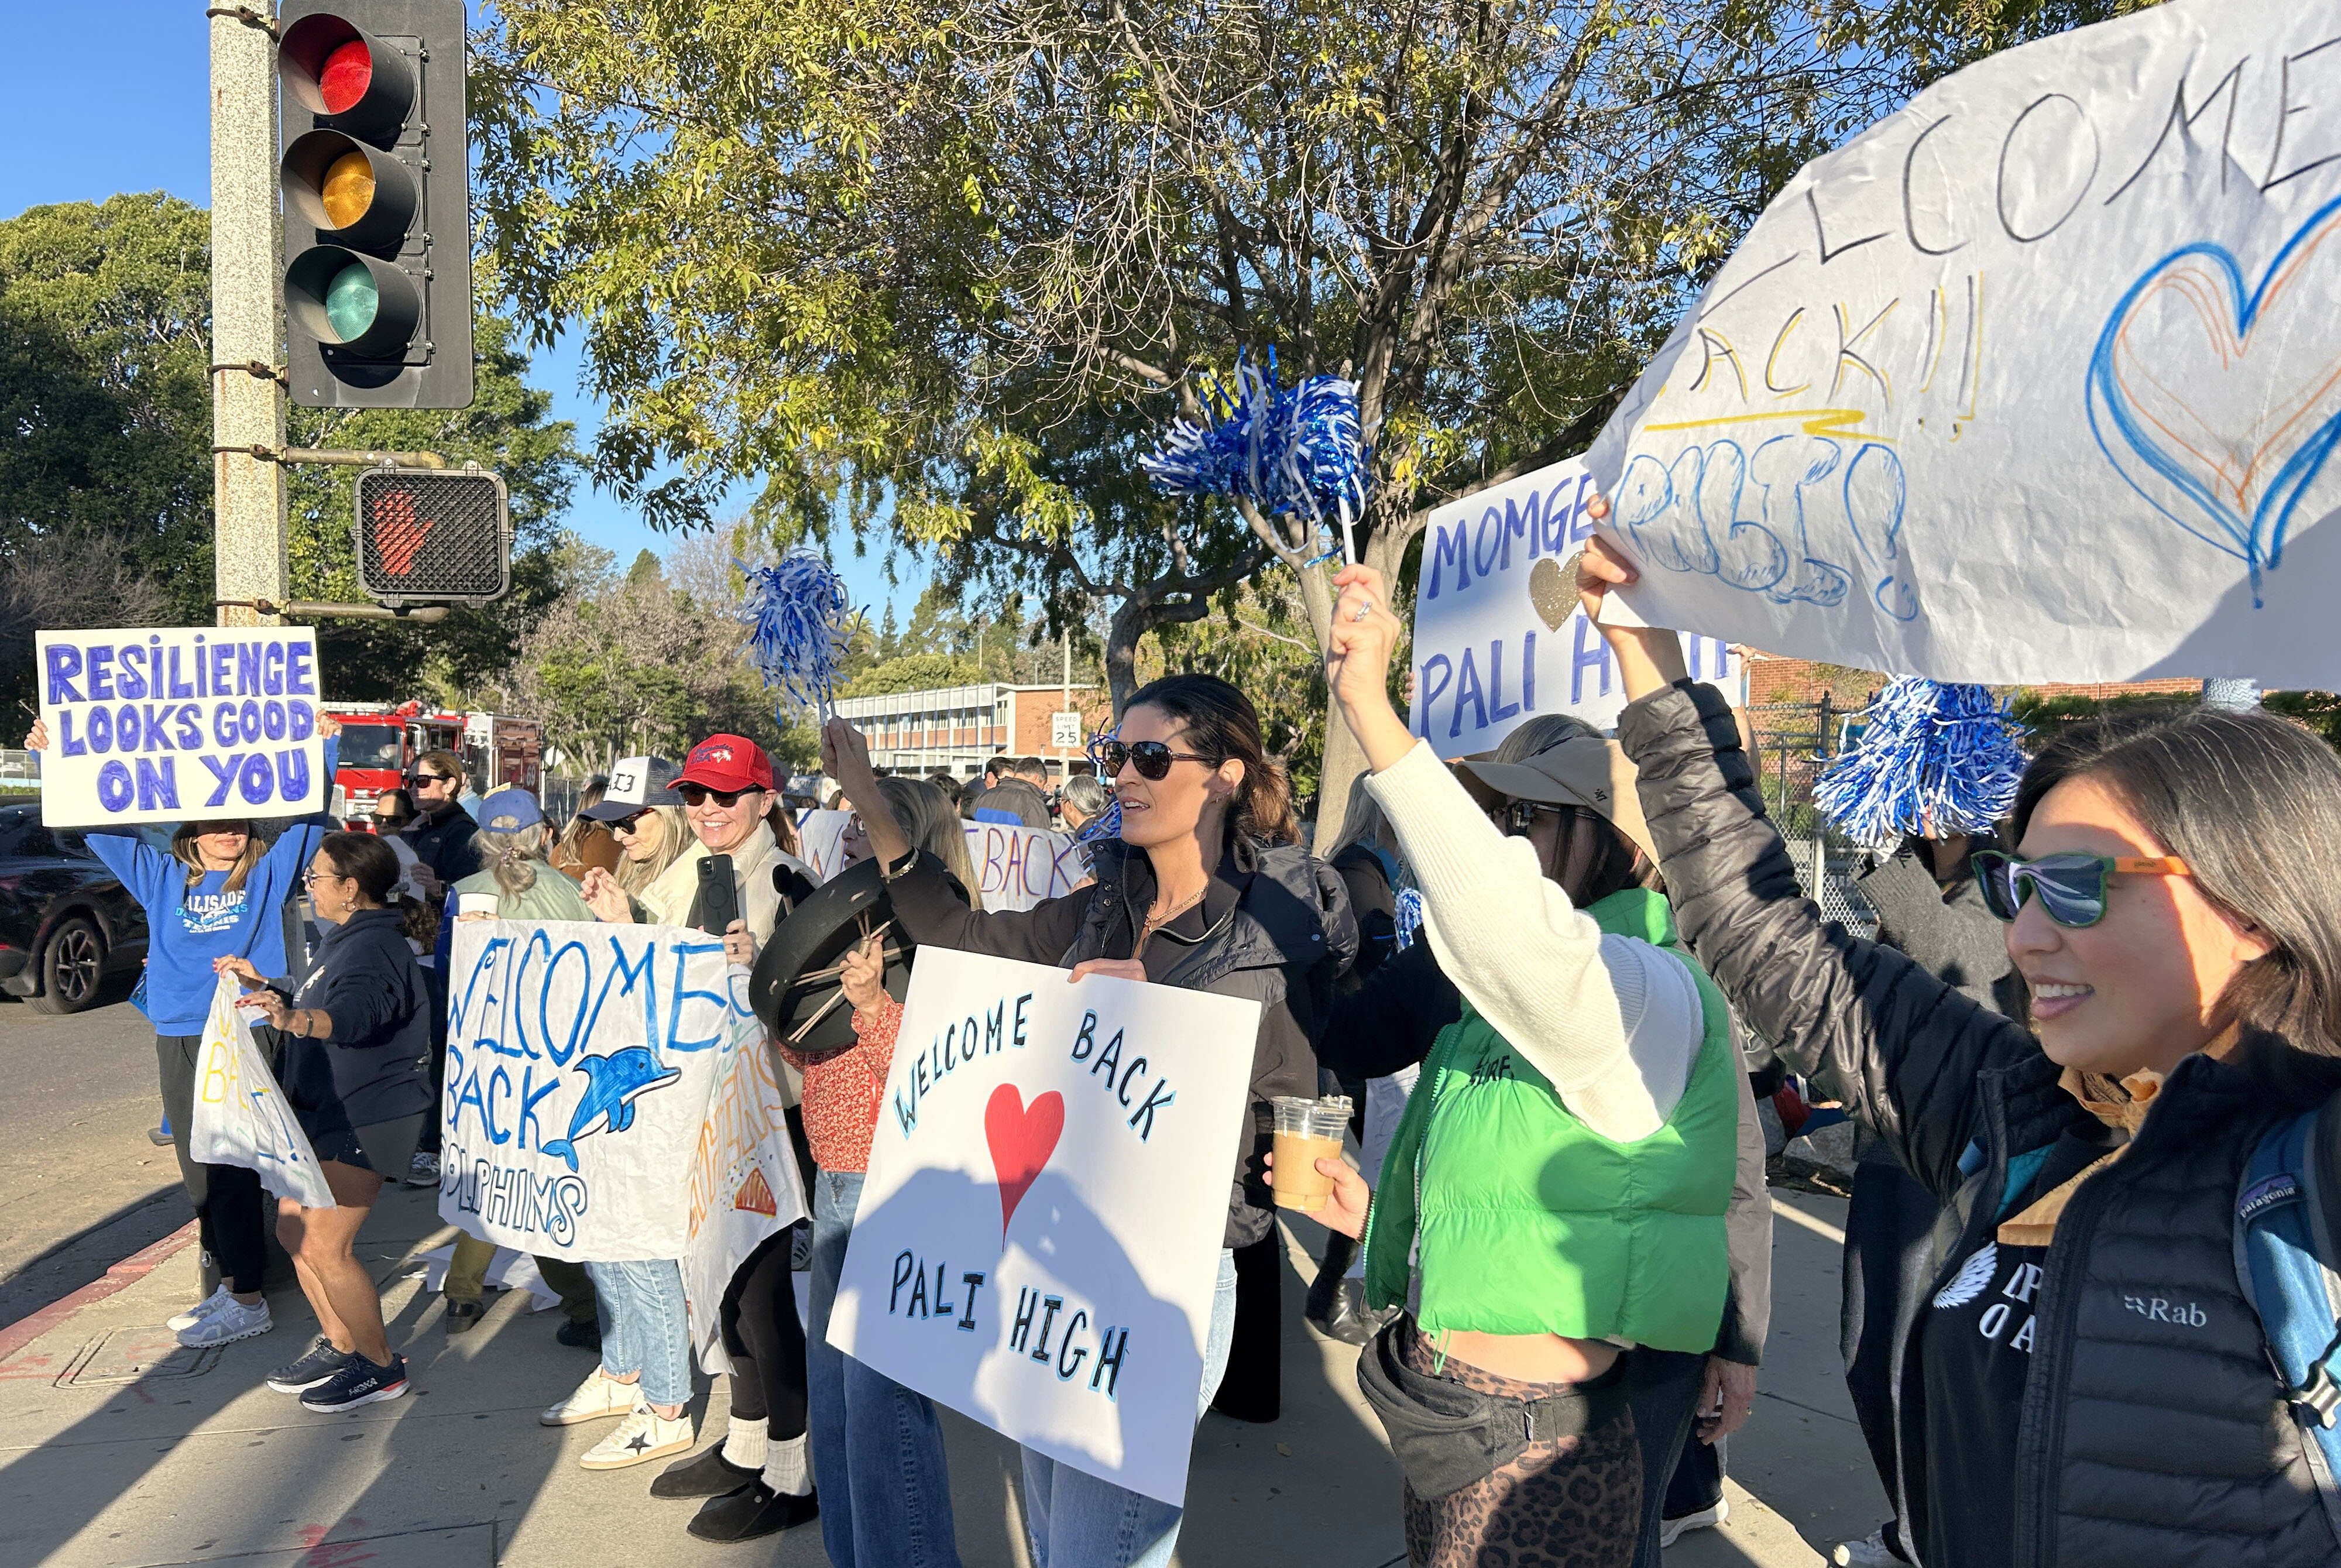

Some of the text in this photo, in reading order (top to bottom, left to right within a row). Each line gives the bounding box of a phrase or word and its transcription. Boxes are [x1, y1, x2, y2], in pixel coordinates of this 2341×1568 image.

[59, 699, 314, 757] LOOKS GOOD
[1420, 630, 1536, 743] PALI
[97, 747, 310, 812] ON YOU
[1056, 732, 1076, 743] 25
[980, 828, 1073, 901] BACK
[447, 928, 727, 1067] WELCOME
[446, 1044, 561, 1154] BACK
[893, 991, 1034, 1141] WELCOME
[1069, 1008, 1176, 1144] BACK
[888, 1248, 1131, 1404] PALI HIGH
[2146, 1296, 2207, 1327] Rab
